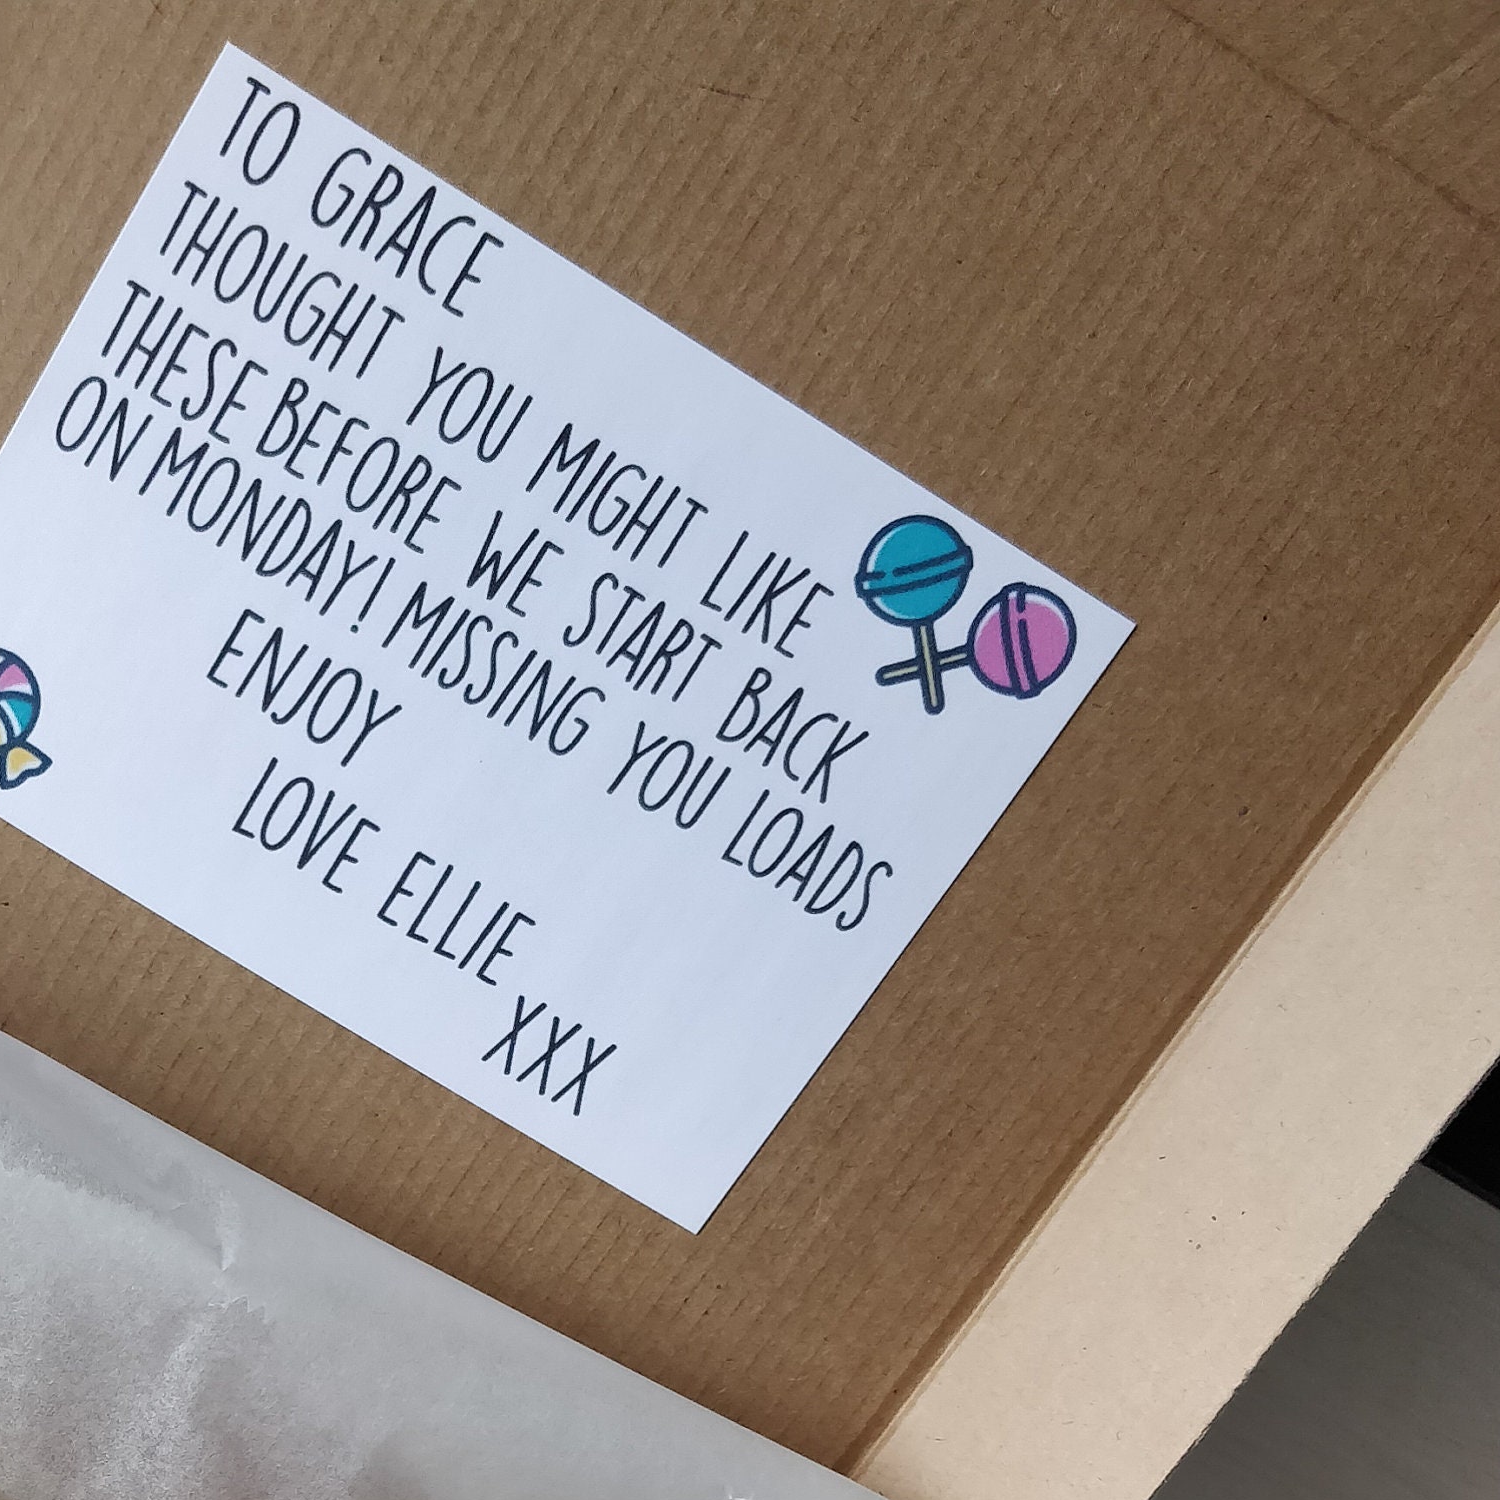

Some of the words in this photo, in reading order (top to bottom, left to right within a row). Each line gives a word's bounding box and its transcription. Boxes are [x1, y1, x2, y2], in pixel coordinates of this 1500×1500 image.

[219, 76, 301, 186] TO
[310, 147, 505, 318] GRACE
[159, 180, 406, 379] THOUGHT
[405, 346, 534, 464] YOU
[525, 422, 709, 569] MIGHT
[699, 530, 835, 659] LIKE
[55, 376, 154, 482] ON
[138, 426, 396, 634] MONDAY!
[381, 581, 606, 756] MISSING
[606, 720, 732, 830] YOU
[721, 788, 894, 932] LOADS
[101, 279, 269, 444] THESE
[255, 377, 462, 555] BEFORE
[466, 509, 565, 618] WE
[562, 572, 723, 703] START
[715, 666, 870, 804] BACK
[206, 608, 403, 768] ENJOY
[231, 756, 381, 894] LOVE
[376, 851, 536, 987] ELLIE
[481, 994, 618, 1117] XXX
